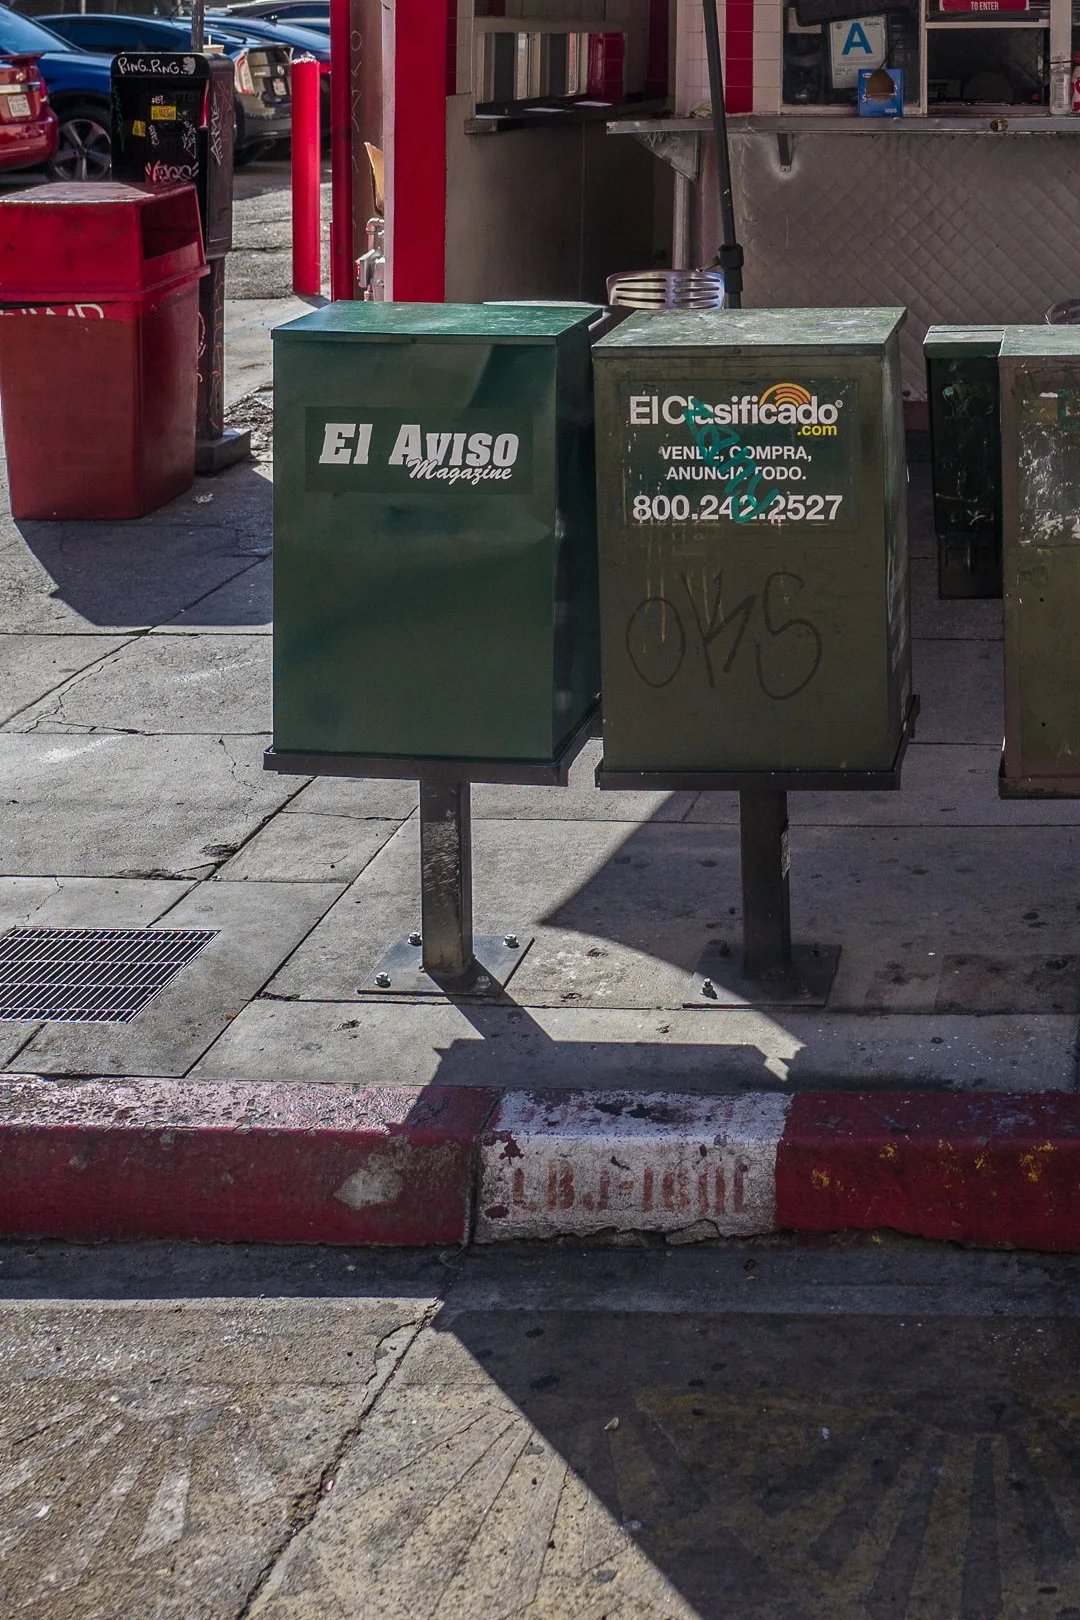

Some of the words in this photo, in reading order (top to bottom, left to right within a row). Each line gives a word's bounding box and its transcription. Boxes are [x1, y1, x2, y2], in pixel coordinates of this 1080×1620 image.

[970, 1, 978, 10] TO
[979, 1, 999, 10] ENTER
[842, 23, 873, 55] A
[629, 395, 659, 425] El
[662, 395, 839, 425] Clasificado
[318, 423, 373, 465] El
[797, 425, 838, 436] .com
[729, 446, 812, 462] COMPRA,
[407, 459, 512, 486] Magazine
[632, 494, 843, 521] 800.242.2527
